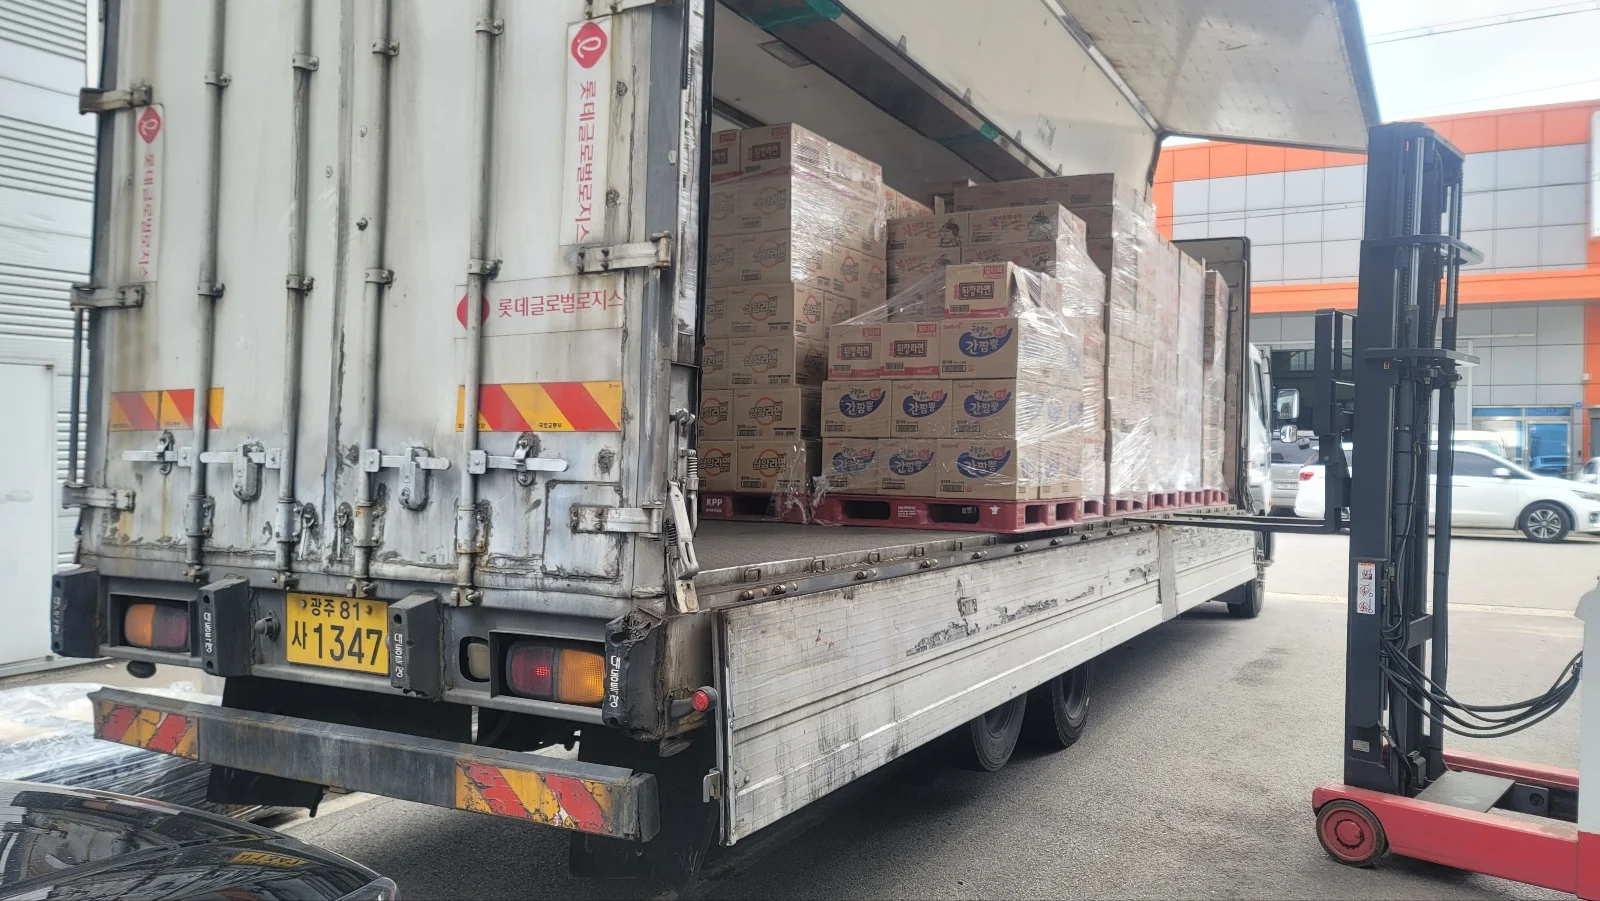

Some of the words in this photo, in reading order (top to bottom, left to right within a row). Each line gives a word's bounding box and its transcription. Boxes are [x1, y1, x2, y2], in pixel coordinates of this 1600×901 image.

[574, 80, 597, 244] 롯데글로벌로지스
[961, 284, 991, 297] 된장라면
[498, 289, 623, 318] 롯데글로벌로지스
[743, 299, 777, 315] 삼양라면
[843, 345, 870, 358] 된장라면
[896, 343, 924, 355] 된장라면
[965, 338, 999, 355] 간짬뽕
[744, 351, 778, 368] 삼양라면
[749, 404, 783, 418] 삼양라면
[845, 400, 874, 416] 간짬뽕
[908, 401, 936, 416] 간짬뽕
[753, 457, 787, 471] 삼양라면
[706, 498, 723, 507] KPP
[310, 597, 335, 618] 광주
[339, 600, 360, 621] 81
